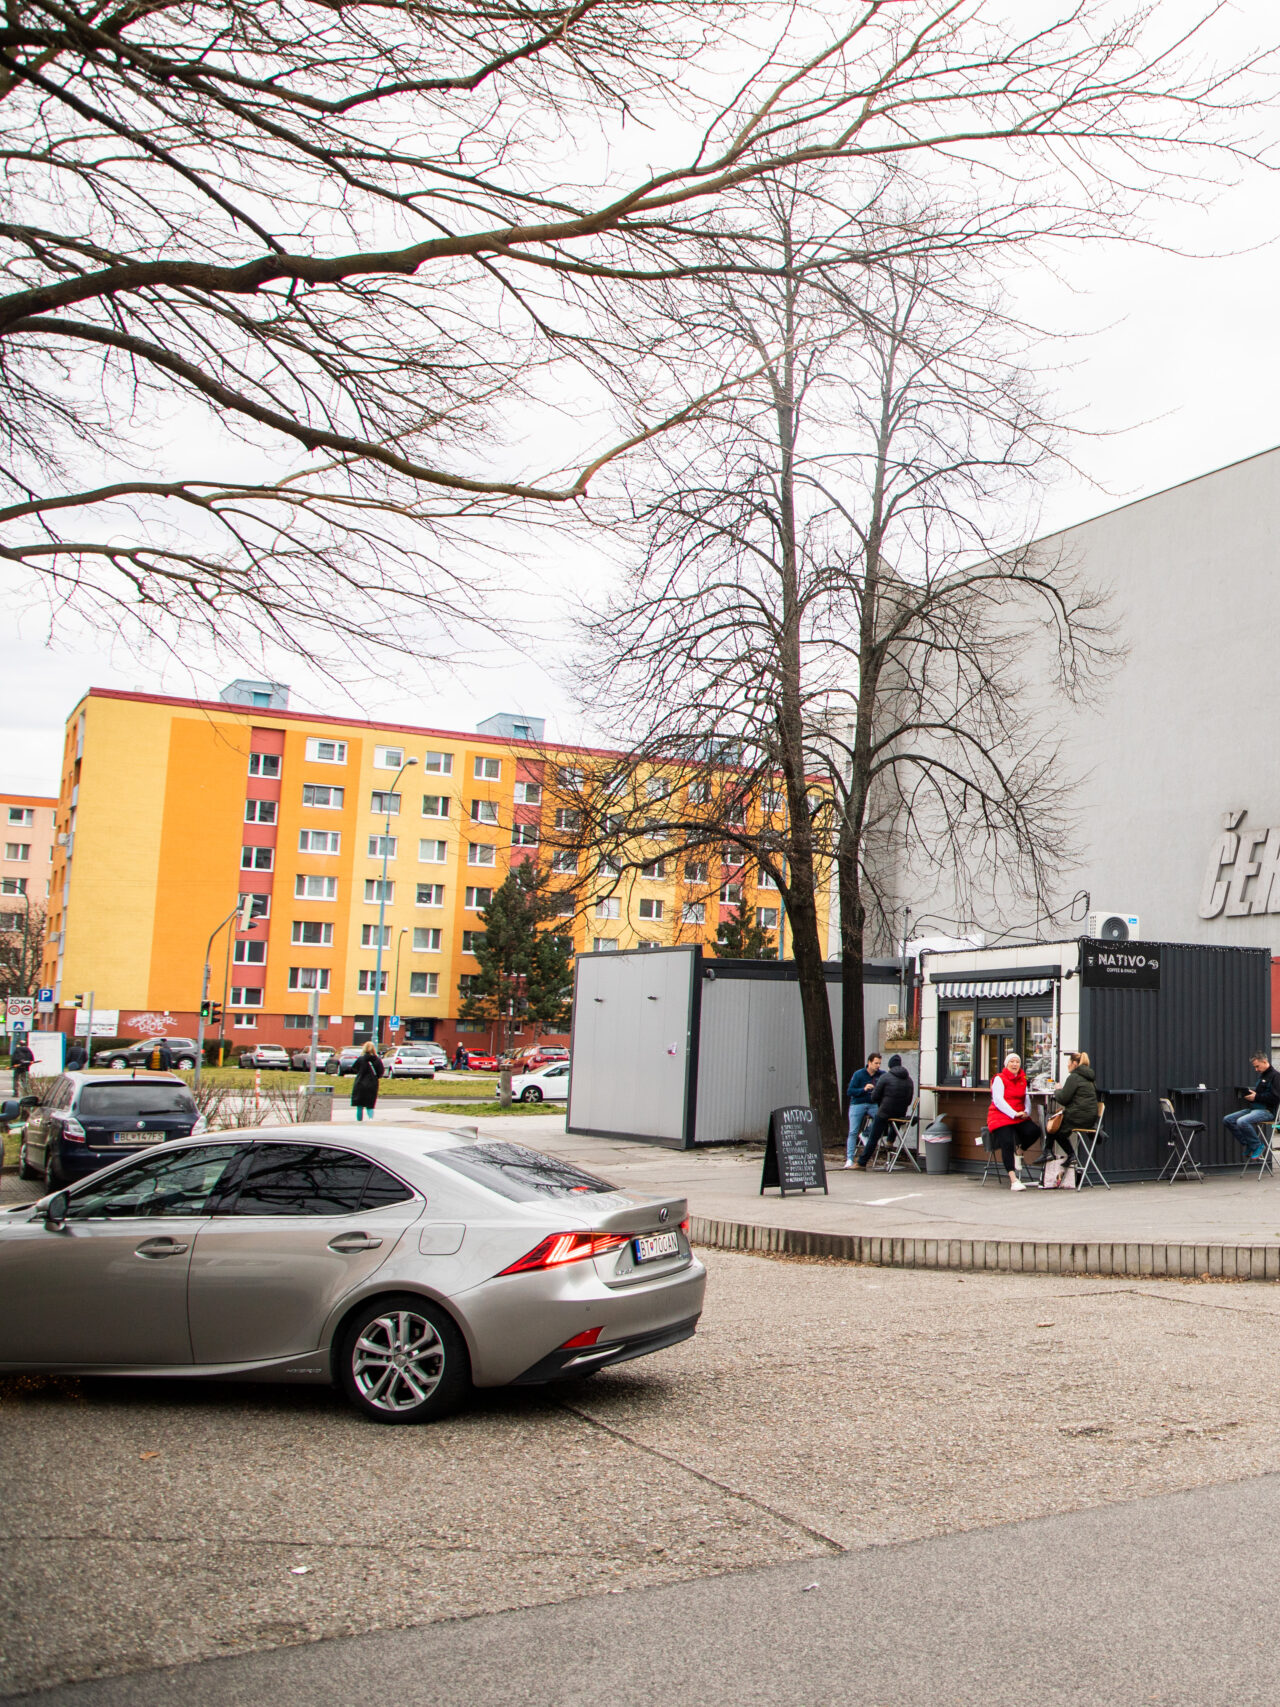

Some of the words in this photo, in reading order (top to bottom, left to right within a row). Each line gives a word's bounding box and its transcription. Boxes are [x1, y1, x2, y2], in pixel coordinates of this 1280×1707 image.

[1098, 953, 1146, 967] NATIVO
[41, 990, 51, 1001] P
[783, 1109, 813, 1123] NATIVO
